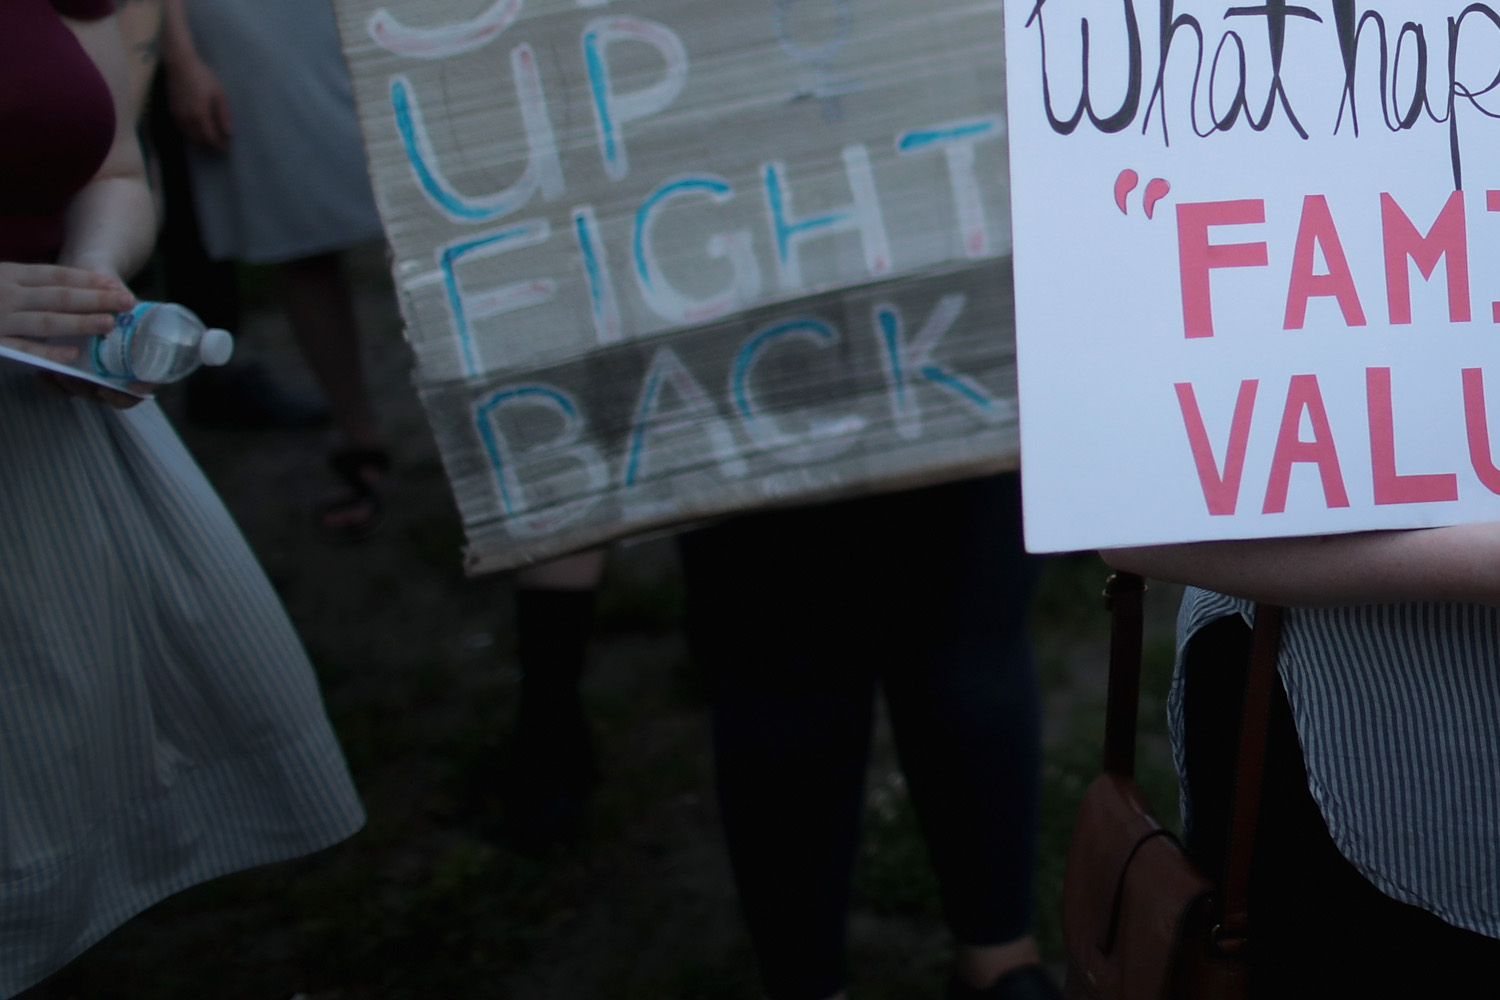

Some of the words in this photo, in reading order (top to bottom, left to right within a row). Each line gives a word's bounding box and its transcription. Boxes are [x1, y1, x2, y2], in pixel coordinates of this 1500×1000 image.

[388, 14, 692, 224] UP
[438, 116, 1002, 382] FIGHT
[473, 292, 1002, 542] BACK
